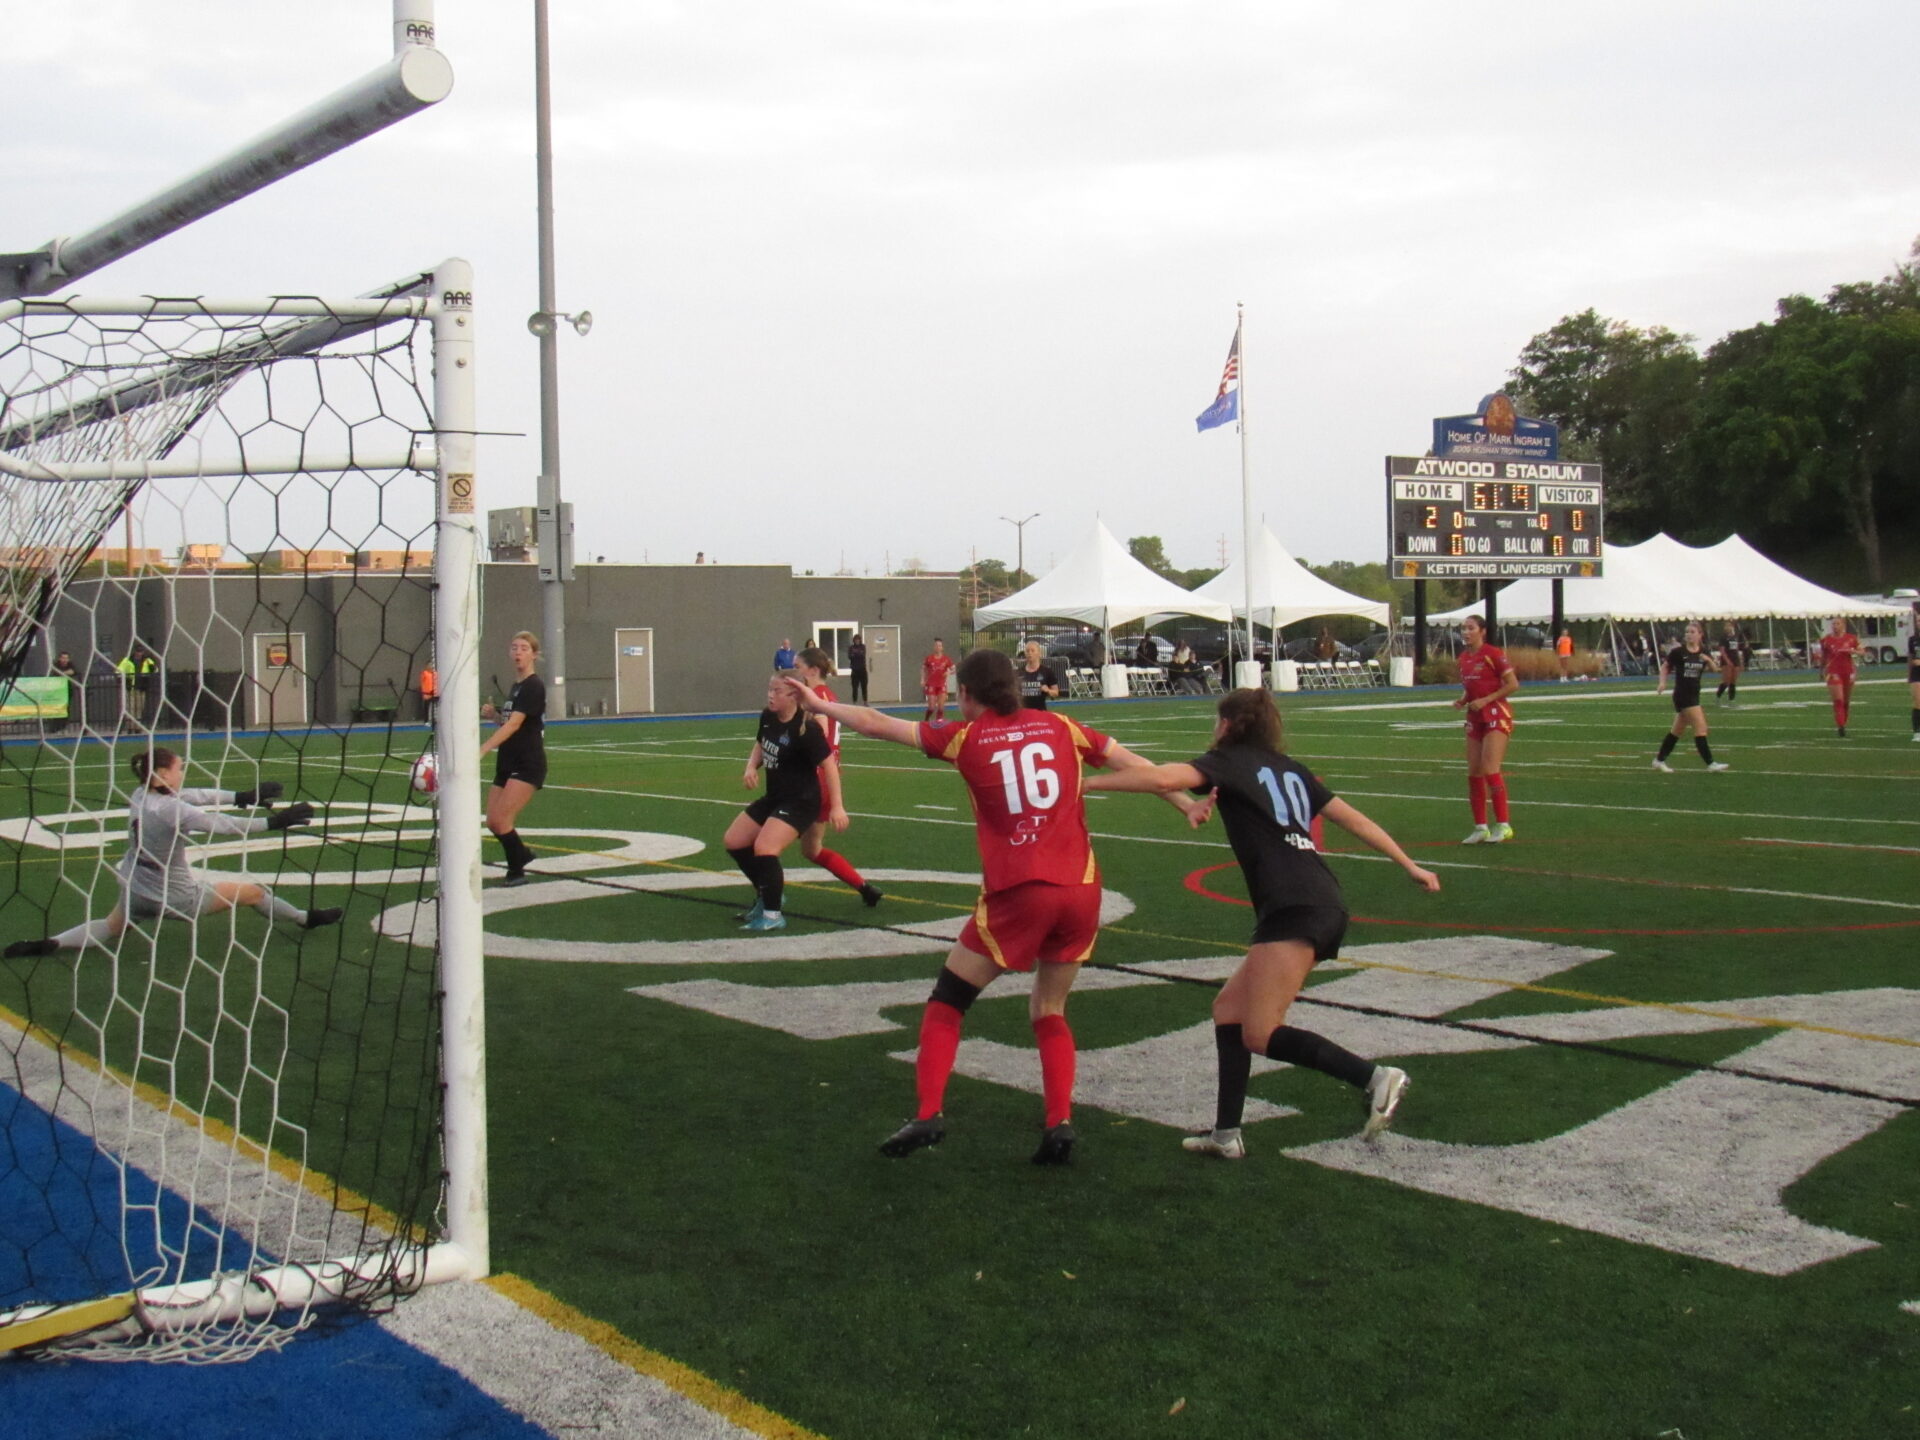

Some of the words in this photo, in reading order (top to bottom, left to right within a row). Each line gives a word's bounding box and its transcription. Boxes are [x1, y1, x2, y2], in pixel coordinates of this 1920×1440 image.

[1489, 432, 1512, 445] MARK
[1514, 434, 1543, 446] INGRAM
[1414, 459, 1495, 477] ATWOOD
[1505, 463, 1582, 480] STADIUM
[1405, 483, 1453, 498] HOME
[1544, 488, 1593, 503] VISITOR
[1425, 506, 1438, 528] 2
[1572, 510, 1582, 531] 0
[1408, 536, 1437, 553] DOWN
[1463, 536, 1476, 553] TO
[1478, 537, 1491, 553] GO
[1504, 537, 1528, 553] BALL
[1530, 537, 1544, 554] ON
[1572, 538, 1590, 554] QTR
[1427, 563, 1497, 574] KETTERING
[1500, 563, 1573, 574] UNIVERSITY
[990, 742, 1060, 814] 16
[1257, 766, 1312, 832] 10
